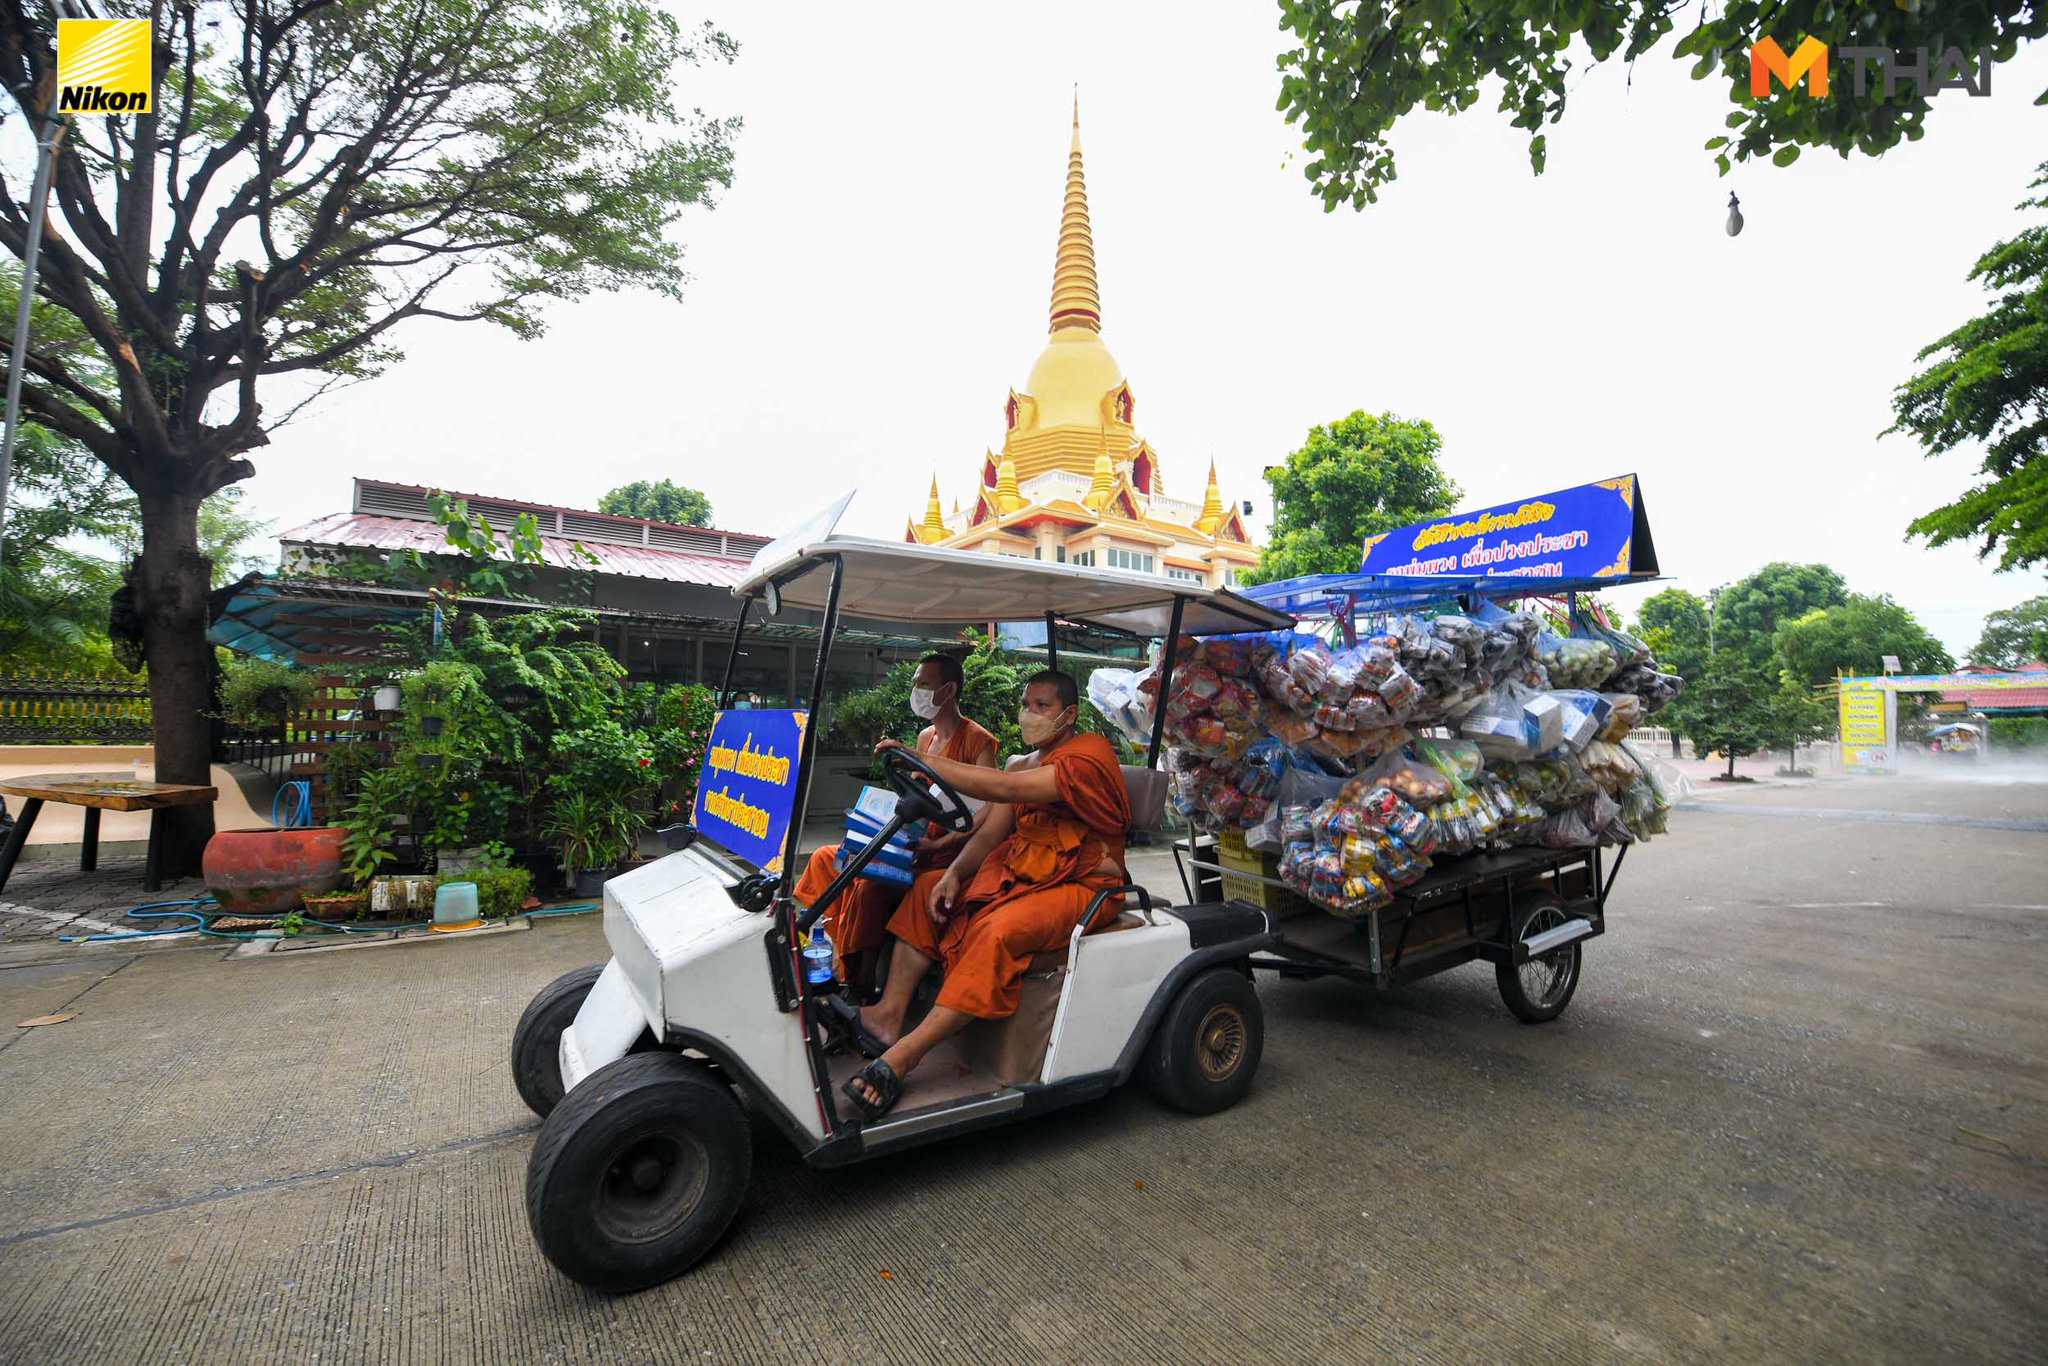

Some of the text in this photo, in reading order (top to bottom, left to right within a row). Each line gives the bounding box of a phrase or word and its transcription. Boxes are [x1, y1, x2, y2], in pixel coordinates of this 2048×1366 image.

[1461, 530, 1588, 567] เพื่อปวงประชา
[735, 731, 790, 787] เพื่อปวงประชา
